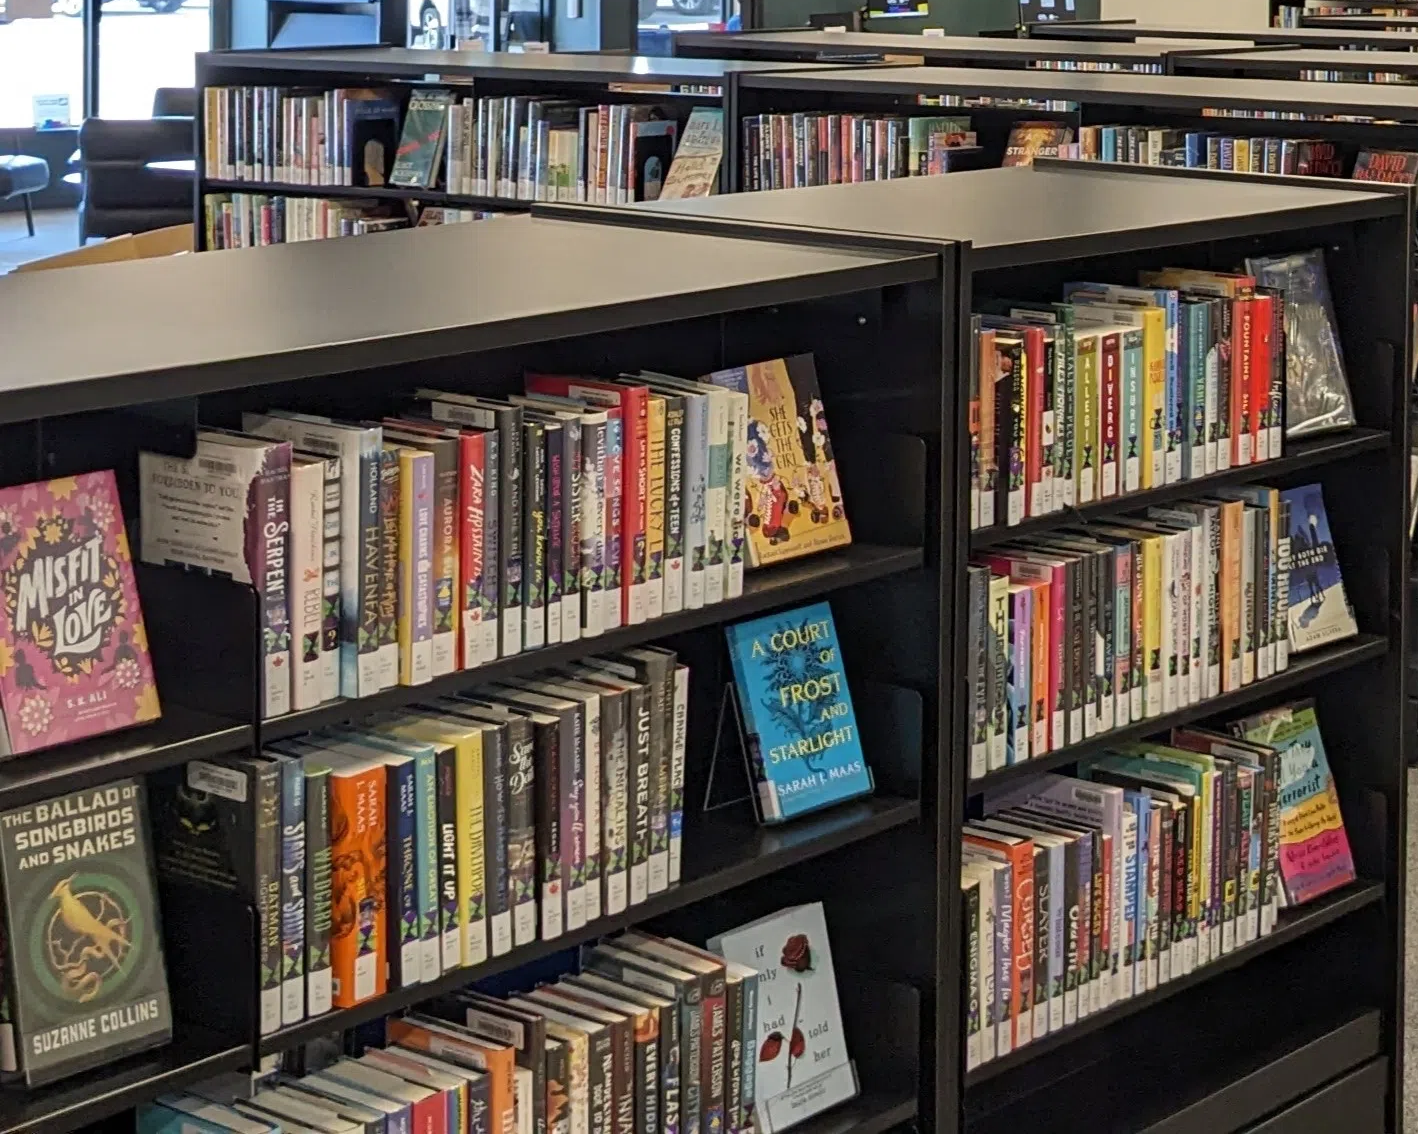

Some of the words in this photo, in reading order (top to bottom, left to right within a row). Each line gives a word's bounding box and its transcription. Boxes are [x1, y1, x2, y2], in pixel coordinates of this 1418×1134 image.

[1006, 146, 1058, 156] STRANGER
[1369, 152, 1407, 171] DAVID
[769, 404, 787, 421] SHE
[769, 421, 792, 438] GETS
[670, 428, 682, 494] CONFESSIONS
[776, 437, 792, 453] THE
[776, 452, 798, 470] GIRL
[368, 462, 379, 514] HOLLAND
[468, 464, 485, 506] ZARA
[650, 475, 665, 533] LUCKY
[669, 510, 681, 534] TEEN
[1297, 557, 1310, 568] THE
[1311, 554, 1324, 565] END
[1302, 548, 1318, 560] BOTH
[16, 535, 103, 632] MISFIT
[68, 585, 84, 606] IN
[363, 527, 379, 626] HAVENFA
[53, 588, 112, 656] LOVE
[751, 640, 765, 658] A
[771, 620, 830, 652] COURT
[819, 648, 834, 664] OF
[89, 691, 107, 703] ALI
[779, 672, 841, 707] FROST
[637, 707, 651, 754] JUST
[820, 703, 849, 722] AND
[769, 725, 853, 764] STARLIGHT
[778, 775, 817, 796] SARAH
[829, 760, 862, 780] MAAS
[4, 811, 33, 828] THE
[35, 786, 120, 823] BALLAD
[122, 784, 140, 800] OF
[356, 792, 365, 834] MAAS
[368, 779, 378, 828] SARAH
[14, 806, 134, 850] SONGBIRDS
[442, 823, 456, 860] LIGHT
[18, 850, 50, 870] AND
[53, 827, 137, 864] SNAKES
[402, 834, 414, 892] THRONE
[314, 846, 332, 933] WILDCARD
[442, 864, 456, 881] IT
[1125, 854, 1137, 922] STAMPED
[442, 883, 456, 901] UP
[268, 881, 279, 947] BATMAN
[1016, 878, 1034, 971] CURSED
[1038, 884, 1049, 964] SLAYER
[755, 944, 765, 958] if
[969, 931, 979, 992] ENIGMA
[759, 967, 778, 982] nly
[32, 1018, 97, 1055] SUZANNE
[100, 999, 159, 1034] COLLINS
[711, 1002, 724, 1037] JAMES
[763, 1016, 786, 1033] had
[808, 1021, 829, 1039] told
[645, 1043, 657, 1090] EVERY
[711, 1039, 724, 1098] PATTERSON
[813, 1046, 832, 1062] her
